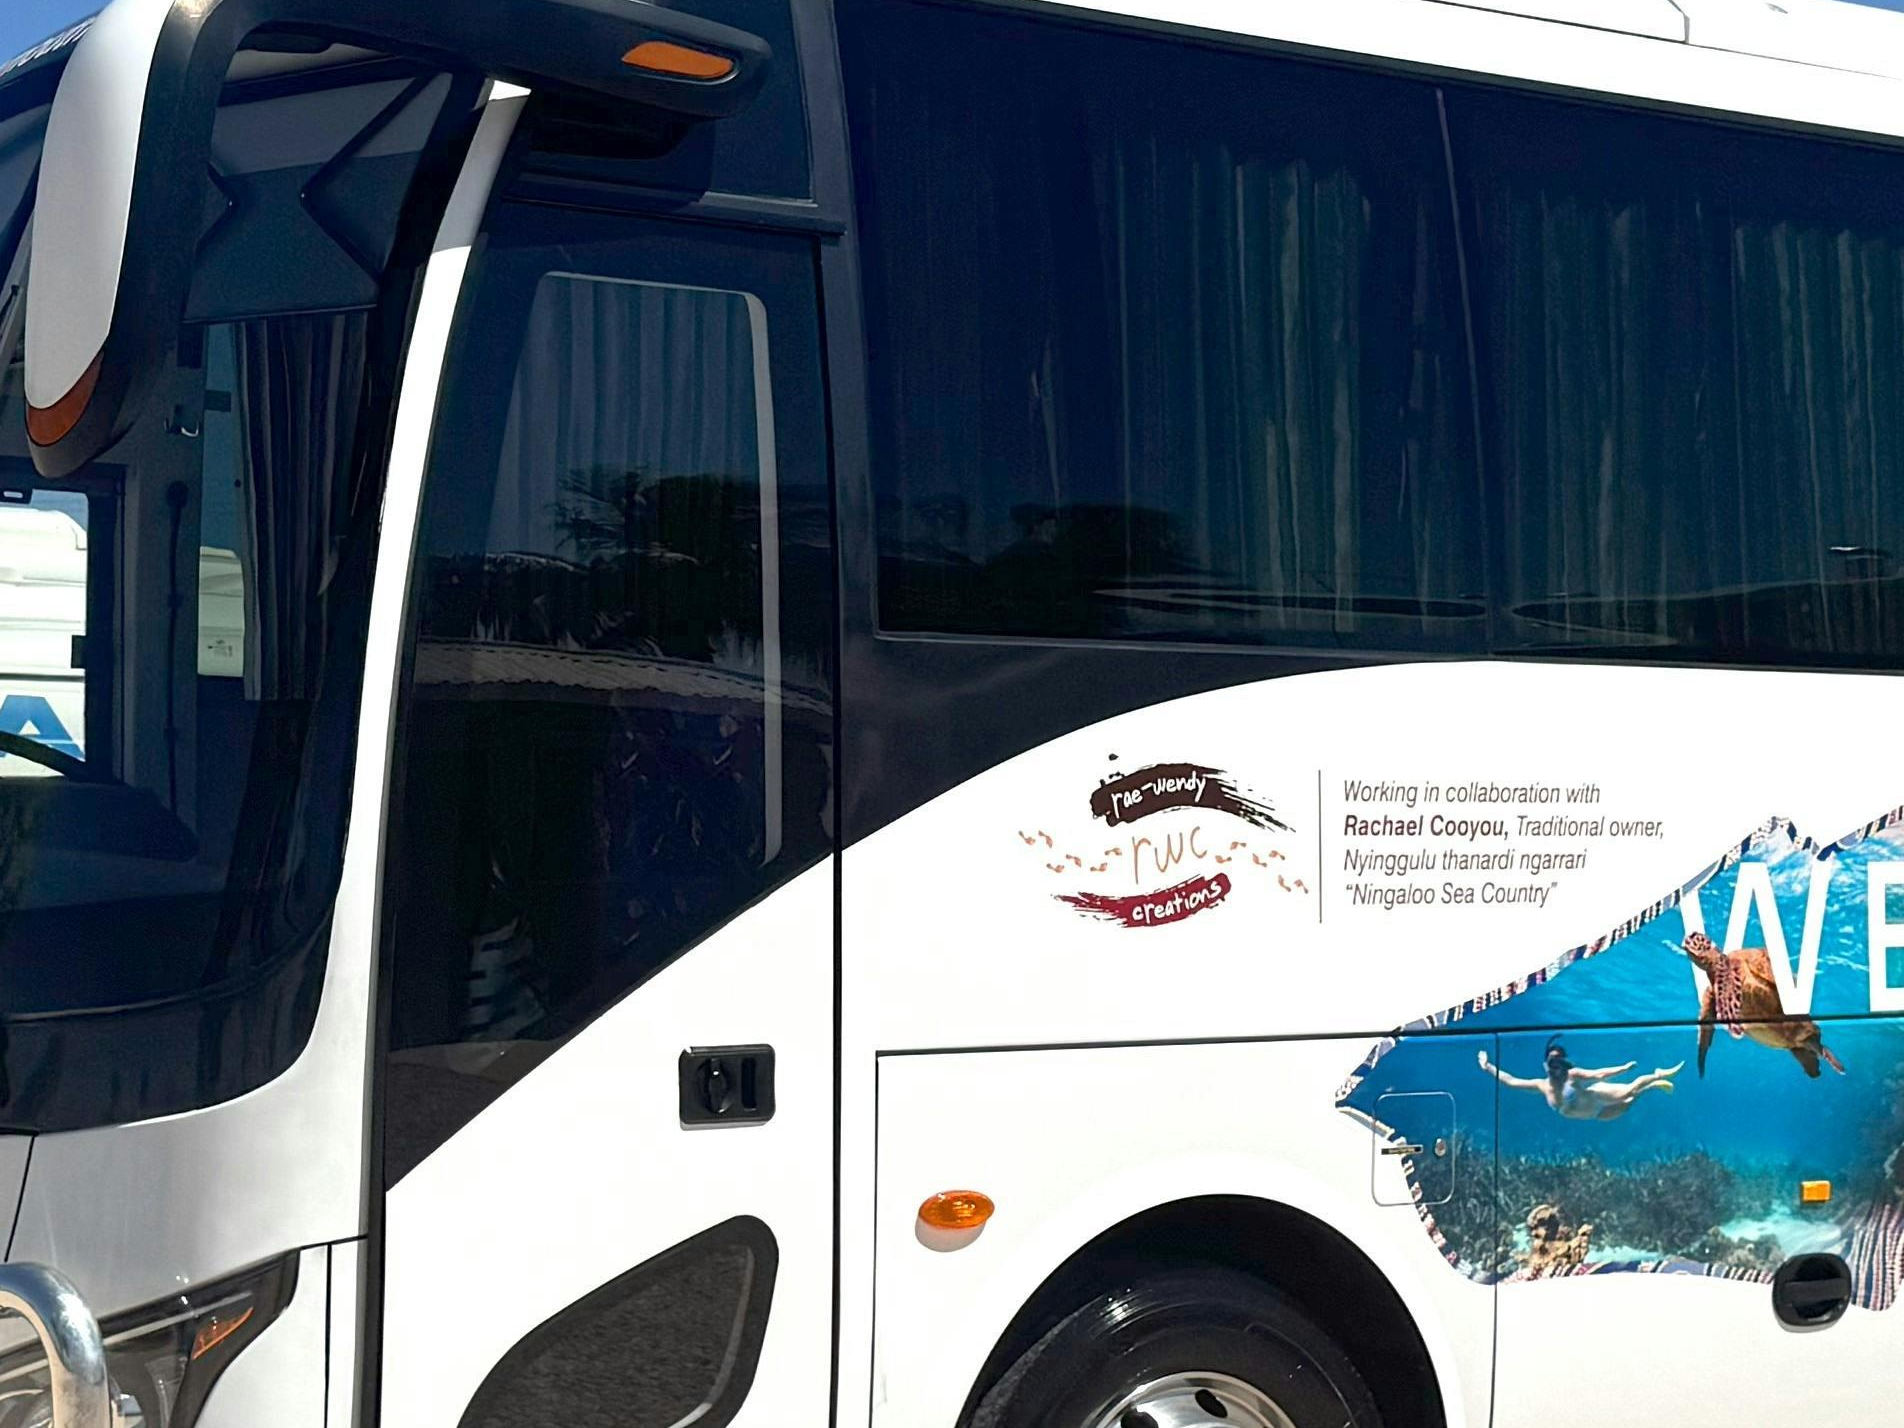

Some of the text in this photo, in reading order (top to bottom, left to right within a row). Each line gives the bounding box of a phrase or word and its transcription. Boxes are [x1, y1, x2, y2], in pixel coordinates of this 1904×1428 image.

[1111, 770, 1206, 819] rae-wendy
[1344, 779, 1601, 808] Working in collaboration with
[1344, 814, 1663, 842] Rachael Cooyou, Traditional owner,
[1344, 848, 1587, 877] Nyinggulu thanardi ngarrari
[1132, 880, 1222, 924] creations
[1441, 882, 1475, 904] Sea
